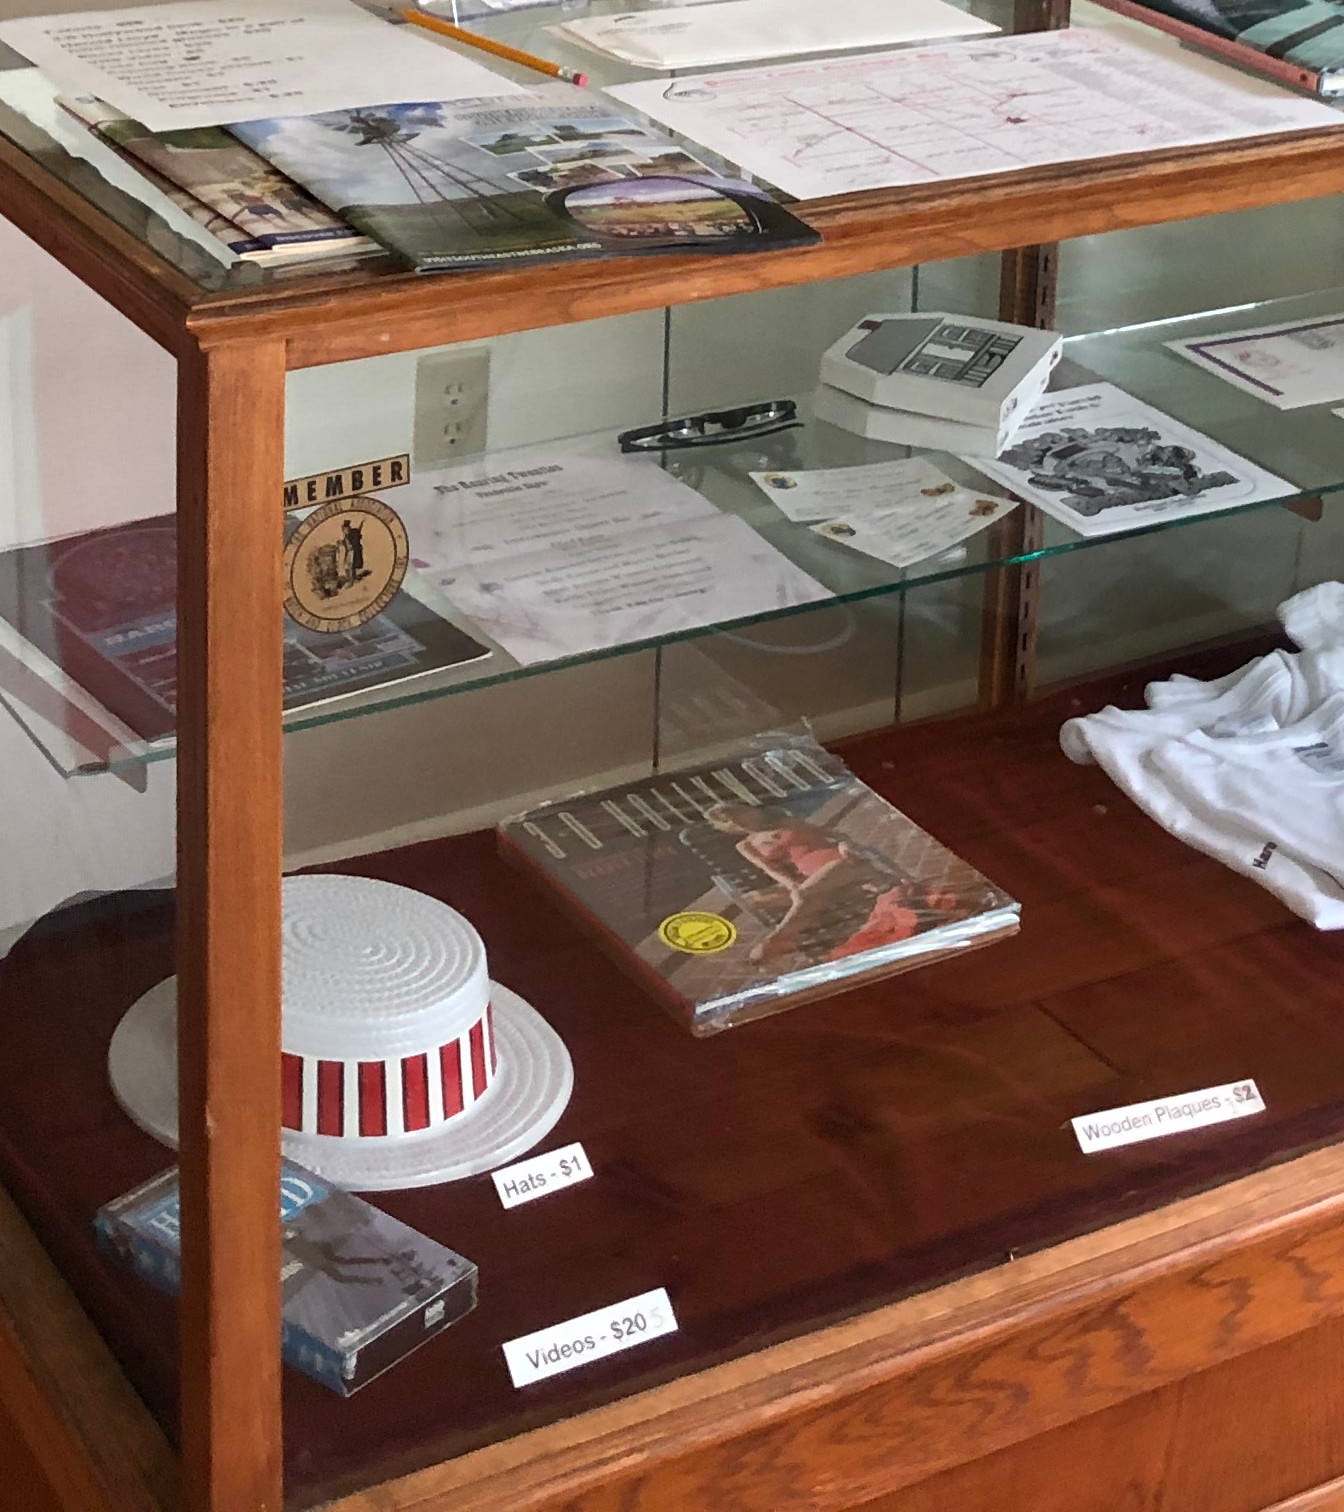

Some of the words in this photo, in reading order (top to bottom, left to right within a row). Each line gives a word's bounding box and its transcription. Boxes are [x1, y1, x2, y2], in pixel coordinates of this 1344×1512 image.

[283, 459, 404, 509] MEMBER
[1082, 1113, 1153, 1141] Wooden
[1154, 1095, 1222, 1123] Plaques
[503, 1172, 547, 1199] Hats
[559, 1155, 582, 1177] $1
[525, 1334, 596, 1370] Videos
[610, 1312, 648, 1340] $20
